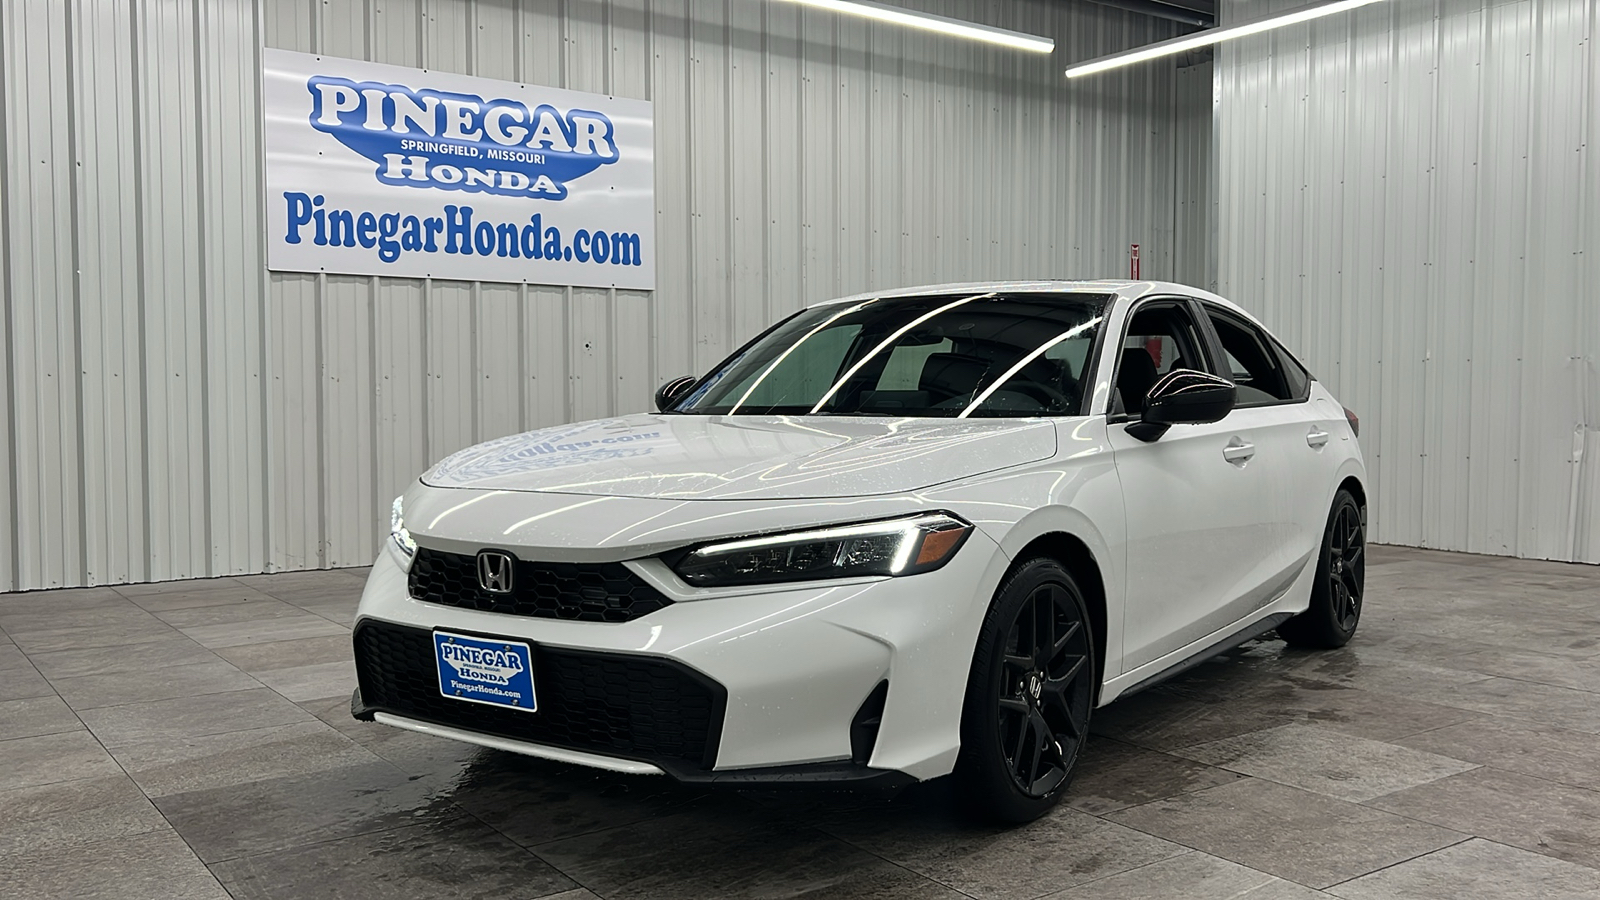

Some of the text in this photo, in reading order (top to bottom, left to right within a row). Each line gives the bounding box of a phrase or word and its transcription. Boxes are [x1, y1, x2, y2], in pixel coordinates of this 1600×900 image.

[314, 83, 614, 158] PINEGAR
[400, 139, 546, 165] SPRINGFIELD, MISSOURI
[382, 153, 562, 194] HONDA
[283, 191, 643, 267] PinegarHonda.com
[443, 645, 522, 670] PINEGAR
[459, 667, 507, 683] HONDA
[450, 679, 521, 698] PinegarHonda.com
